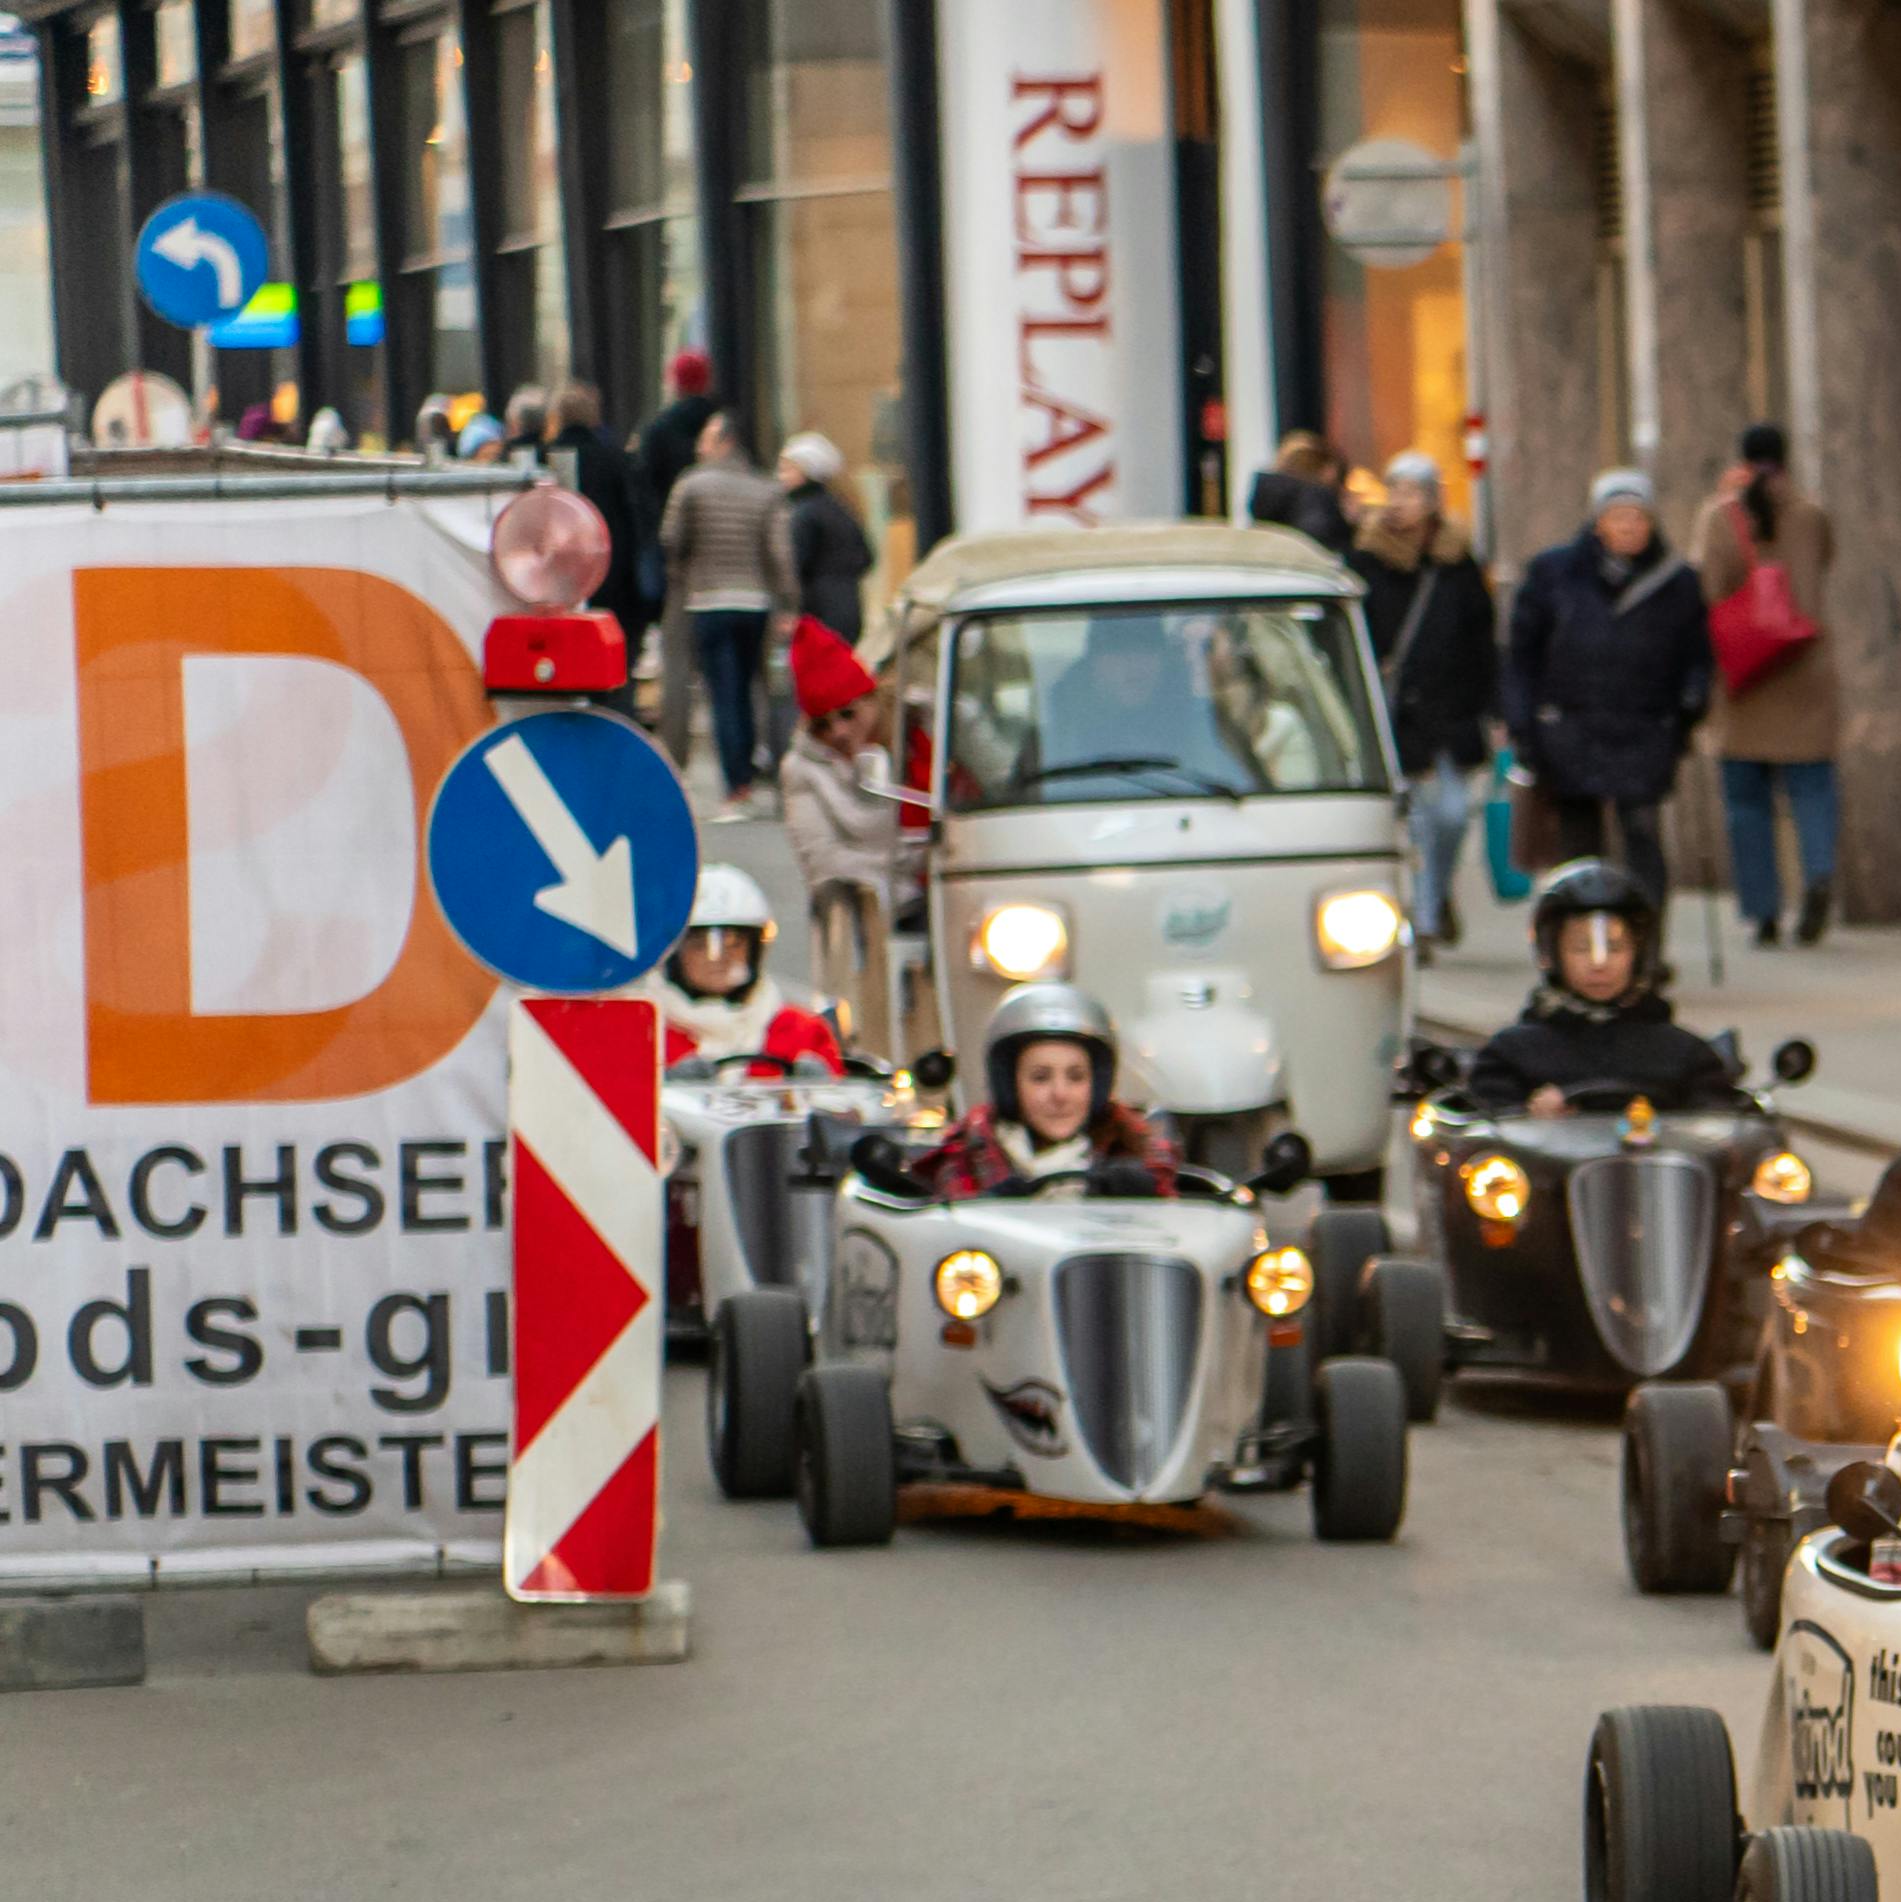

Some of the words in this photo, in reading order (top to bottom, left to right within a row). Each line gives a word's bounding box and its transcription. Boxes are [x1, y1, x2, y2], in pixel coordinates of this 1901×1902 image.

[1008, 72, 1116, 530] REPLAY
[0, 1432, 507, 1525] RMEISTE
[1864, 1771, 1898, 1820] you
